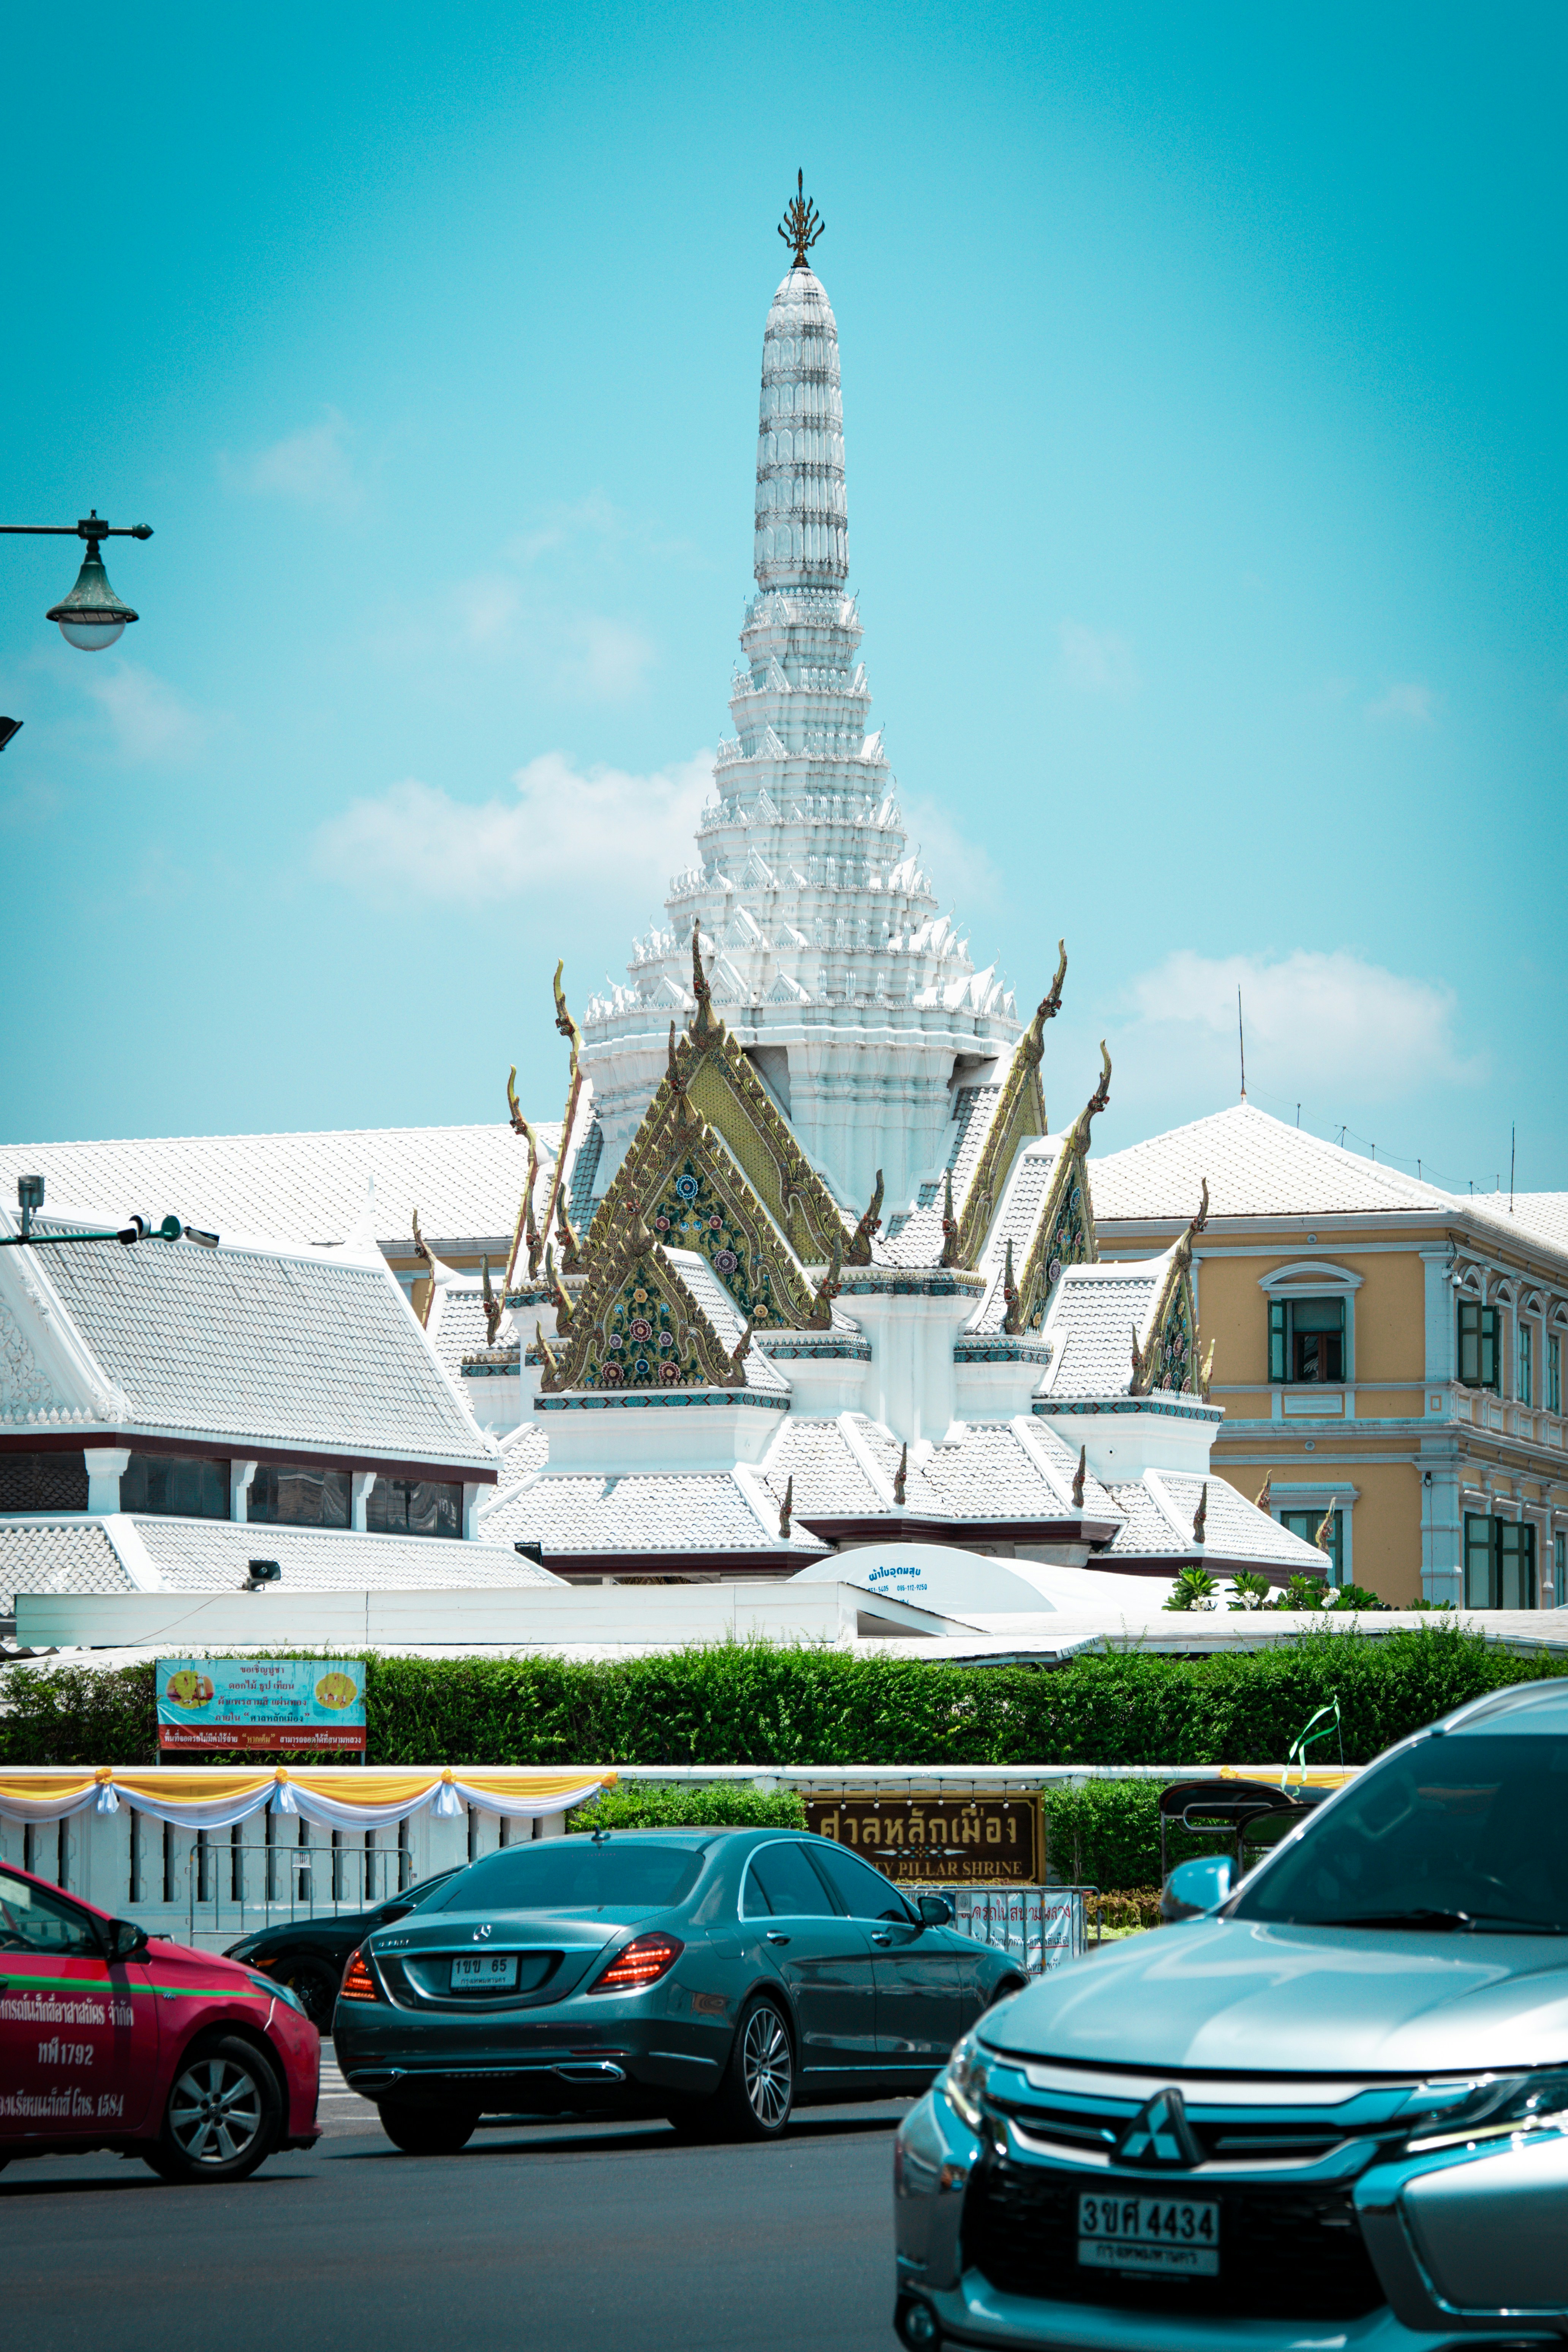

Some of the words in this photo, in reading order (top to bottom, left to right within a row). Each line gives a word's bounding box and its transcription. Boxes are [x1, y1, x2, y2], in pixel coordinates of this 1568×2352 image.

[240, 1664, 284, 1676] ขอเชิญบูชา
[229, 1679, 256, 1690] ดอกไม้
[259, 1680, 271, 1692] ธูป
[273, 1680, 294, 1690] เทียน
[218, 1696, 269, 1706] ผ้าแพรสามสี
[272, 1696, 307, 1706] แผ่นทอง
[215, 1712, 240, 1721] ภายใน
[820, 1808, 1016, 1845] ศาลหลักเมือง
[899, 1862, 958, 1876] PILLAR
[963, 1861, 1022, 1875] SHRINE
[492, 1958, 507, 1972] 65
[108, 2000, 134, 2026] จำกัด
[61, 2043, 94, 2065] 1792
[97, 2094, 124, 2117] 1584
[1147, 2205, 1213, 2240] 4434
